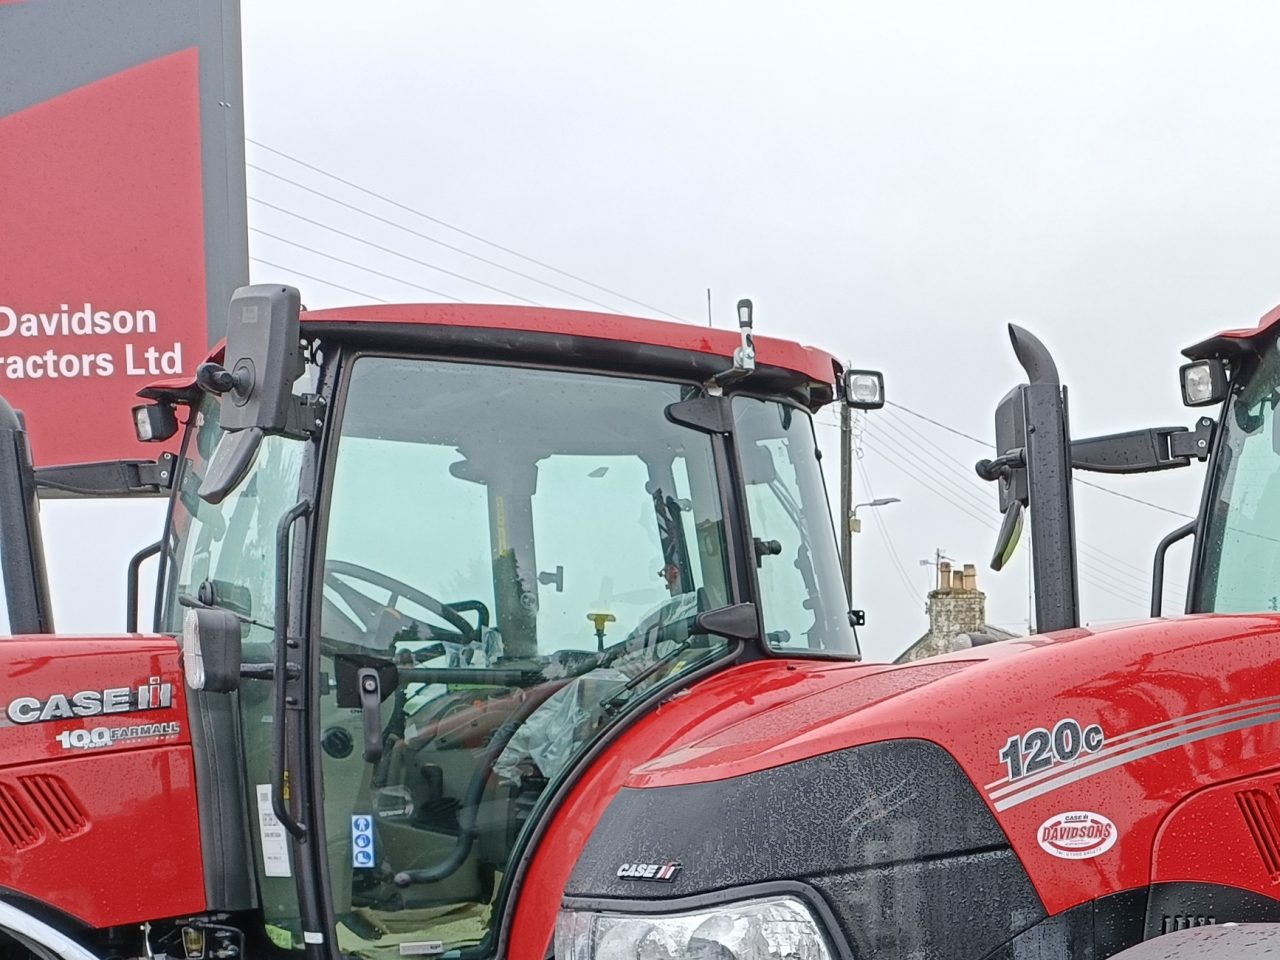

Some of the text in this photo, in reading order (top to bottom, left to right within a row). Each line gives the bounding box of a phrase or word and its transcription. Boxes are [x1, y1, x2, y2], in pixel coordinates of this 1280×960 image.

[0, 303, 157, 337] Davidson
[125, 342, 183, 376] Ltd
[7, 687, 131, 724] CASE
[55, 727, 113, 749] 100
[111, 721, 180, 740] FARMALL
[1041, 822, 1112, 843] DAVIDSONS
[616, 863, 659, 878] CASE
